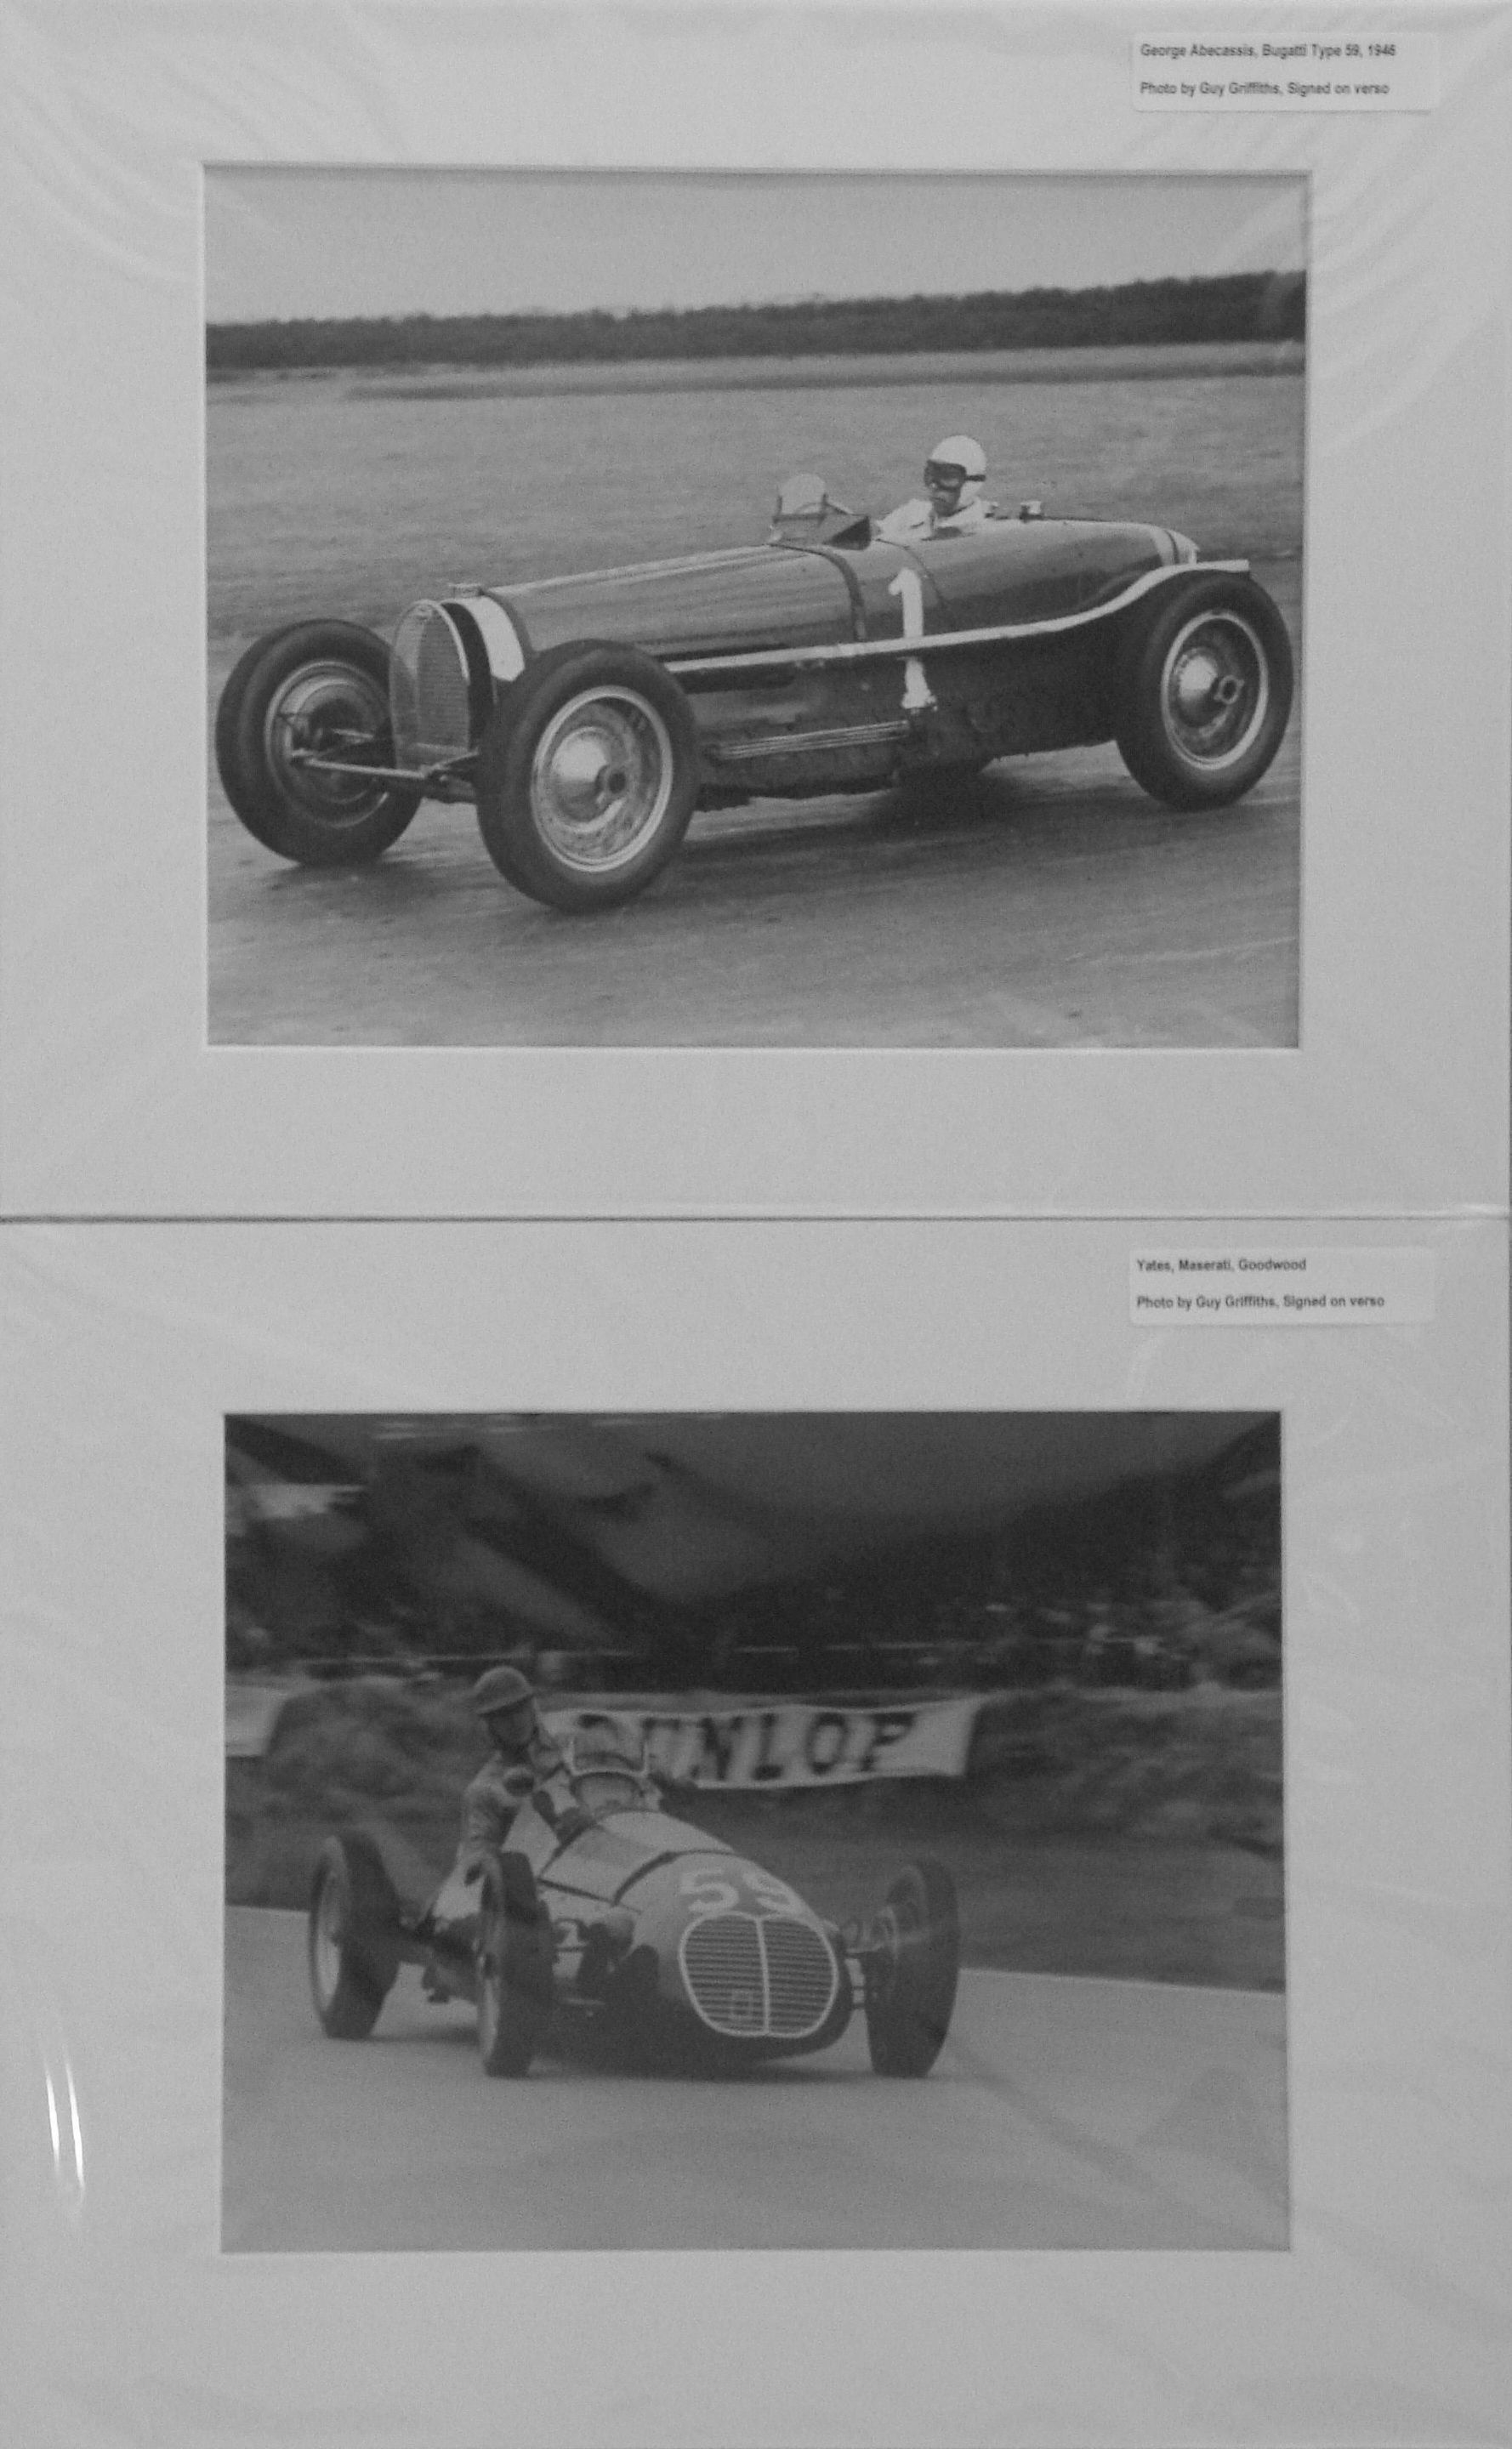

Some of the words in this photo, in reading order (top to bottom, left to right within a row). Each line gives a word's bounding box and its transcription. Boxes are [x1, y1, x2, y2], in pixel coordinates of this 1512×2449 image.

[1140, 43, 1187, 60] George
[1190, 43, 1259, 58] Abecassis,
[1261, 43, 1308, 60] Bugatti
[1311, 43, 1343, 60] Type
[1344, 43, 1364, 58] 59,
[1140, 82, 1178, 94] Photo
[1179, 82, 1197, 98] by
[1199, 82, 1226, 98] Guy
[1228, 82, 1284, 94] Griffiths,
[1287, 82, 1332, 98] Signed
[1333, 84, 1351, 94] on
[1354, 84, 1391, 94] verso
[1136, 1259, 1175, 1274] Yates,
[1178, 1259, 1235, 1272] Maserati,
[1237, 1258, 1307, 1271] Goodwood
[1136, 1295, 1174, 1309] Photo
[1176, 1295, 1193, 1311] by
[1195, 1294, 1222, 1311] Guy
[1225, 1294, 1280, 1308] Griffiths,
[1282, 1294, 1327, 1311] Signed
[1329, 1297, 1346, 1308] on
[1349, 1297, 1385, 1308] verso
